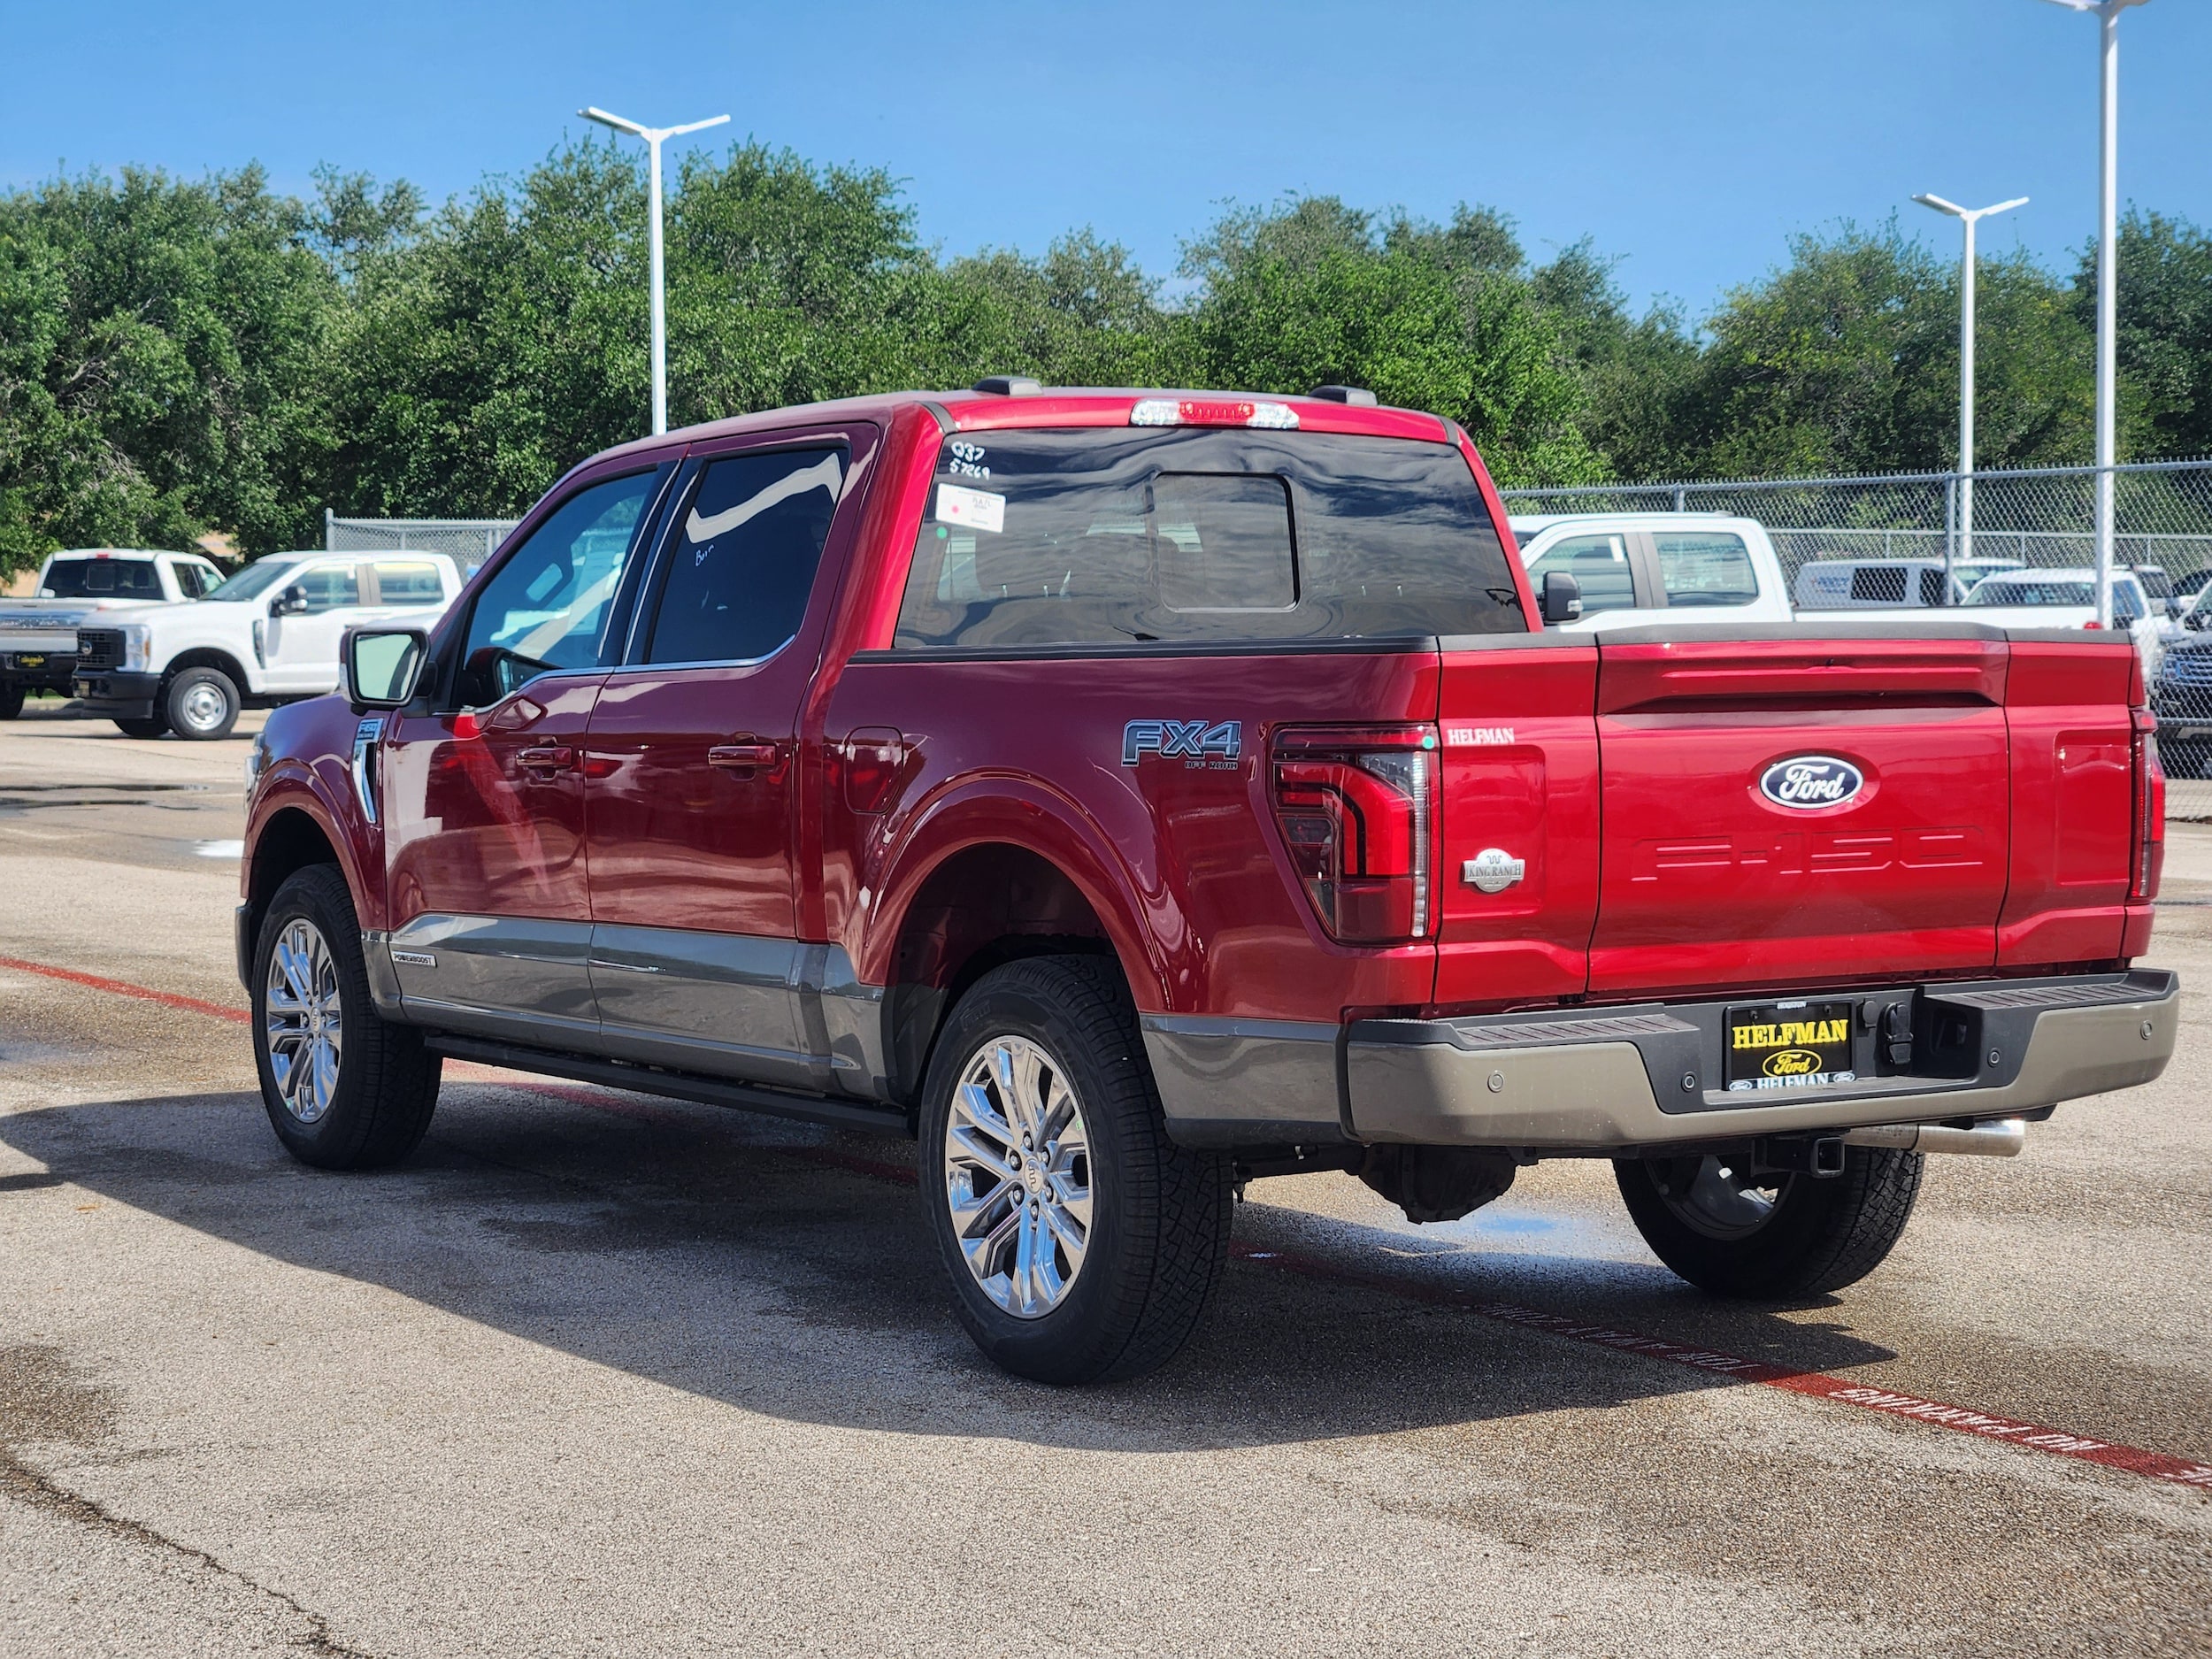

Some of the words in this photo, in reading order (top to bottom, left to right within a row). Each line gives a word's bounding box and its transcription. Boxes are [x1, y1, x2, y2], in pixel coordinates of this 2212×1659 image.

[1121, 719, 1241, 767] FX4
[1448, 727, 1515, 746] HELFMAN
[1779, 764, 1846, 800] Ford
[1469, 865, 1490, 877] KING
[1492, 864, 1521, 877] RANCH
[1732, 1019, 1849, 1049] HELFMAN
[1773, 1053, 1811, 1075] Ford
